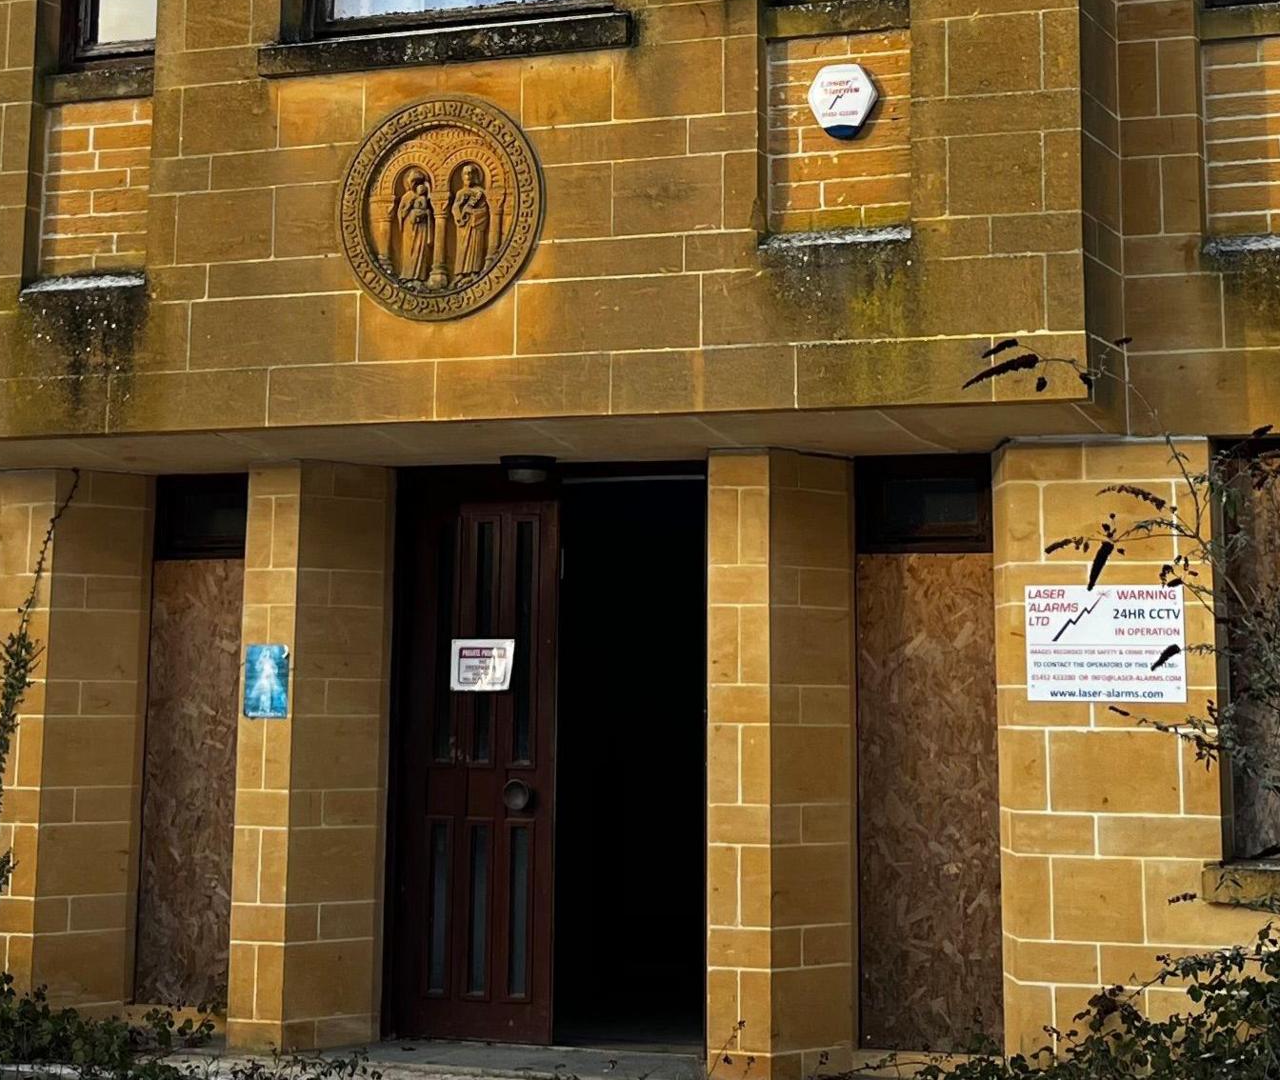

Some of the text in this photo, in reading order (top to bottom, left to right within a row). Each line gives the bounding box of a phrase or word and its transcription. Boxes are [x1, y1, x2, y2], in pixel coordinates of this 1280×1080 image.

[1028, 589, 1065, 599] LASER
[1117, 590, 1176, 600] WARNING
[1029, 603, 1078, 612] ALARMS
[1113, 609, 1180, 620] 24HR CCTV
[1029, 616, 1049, 626] LTD
[1128, 628, 1180, 636] OPERATION
[1050, 689, 1163, 698] www.laser-alarms.com
